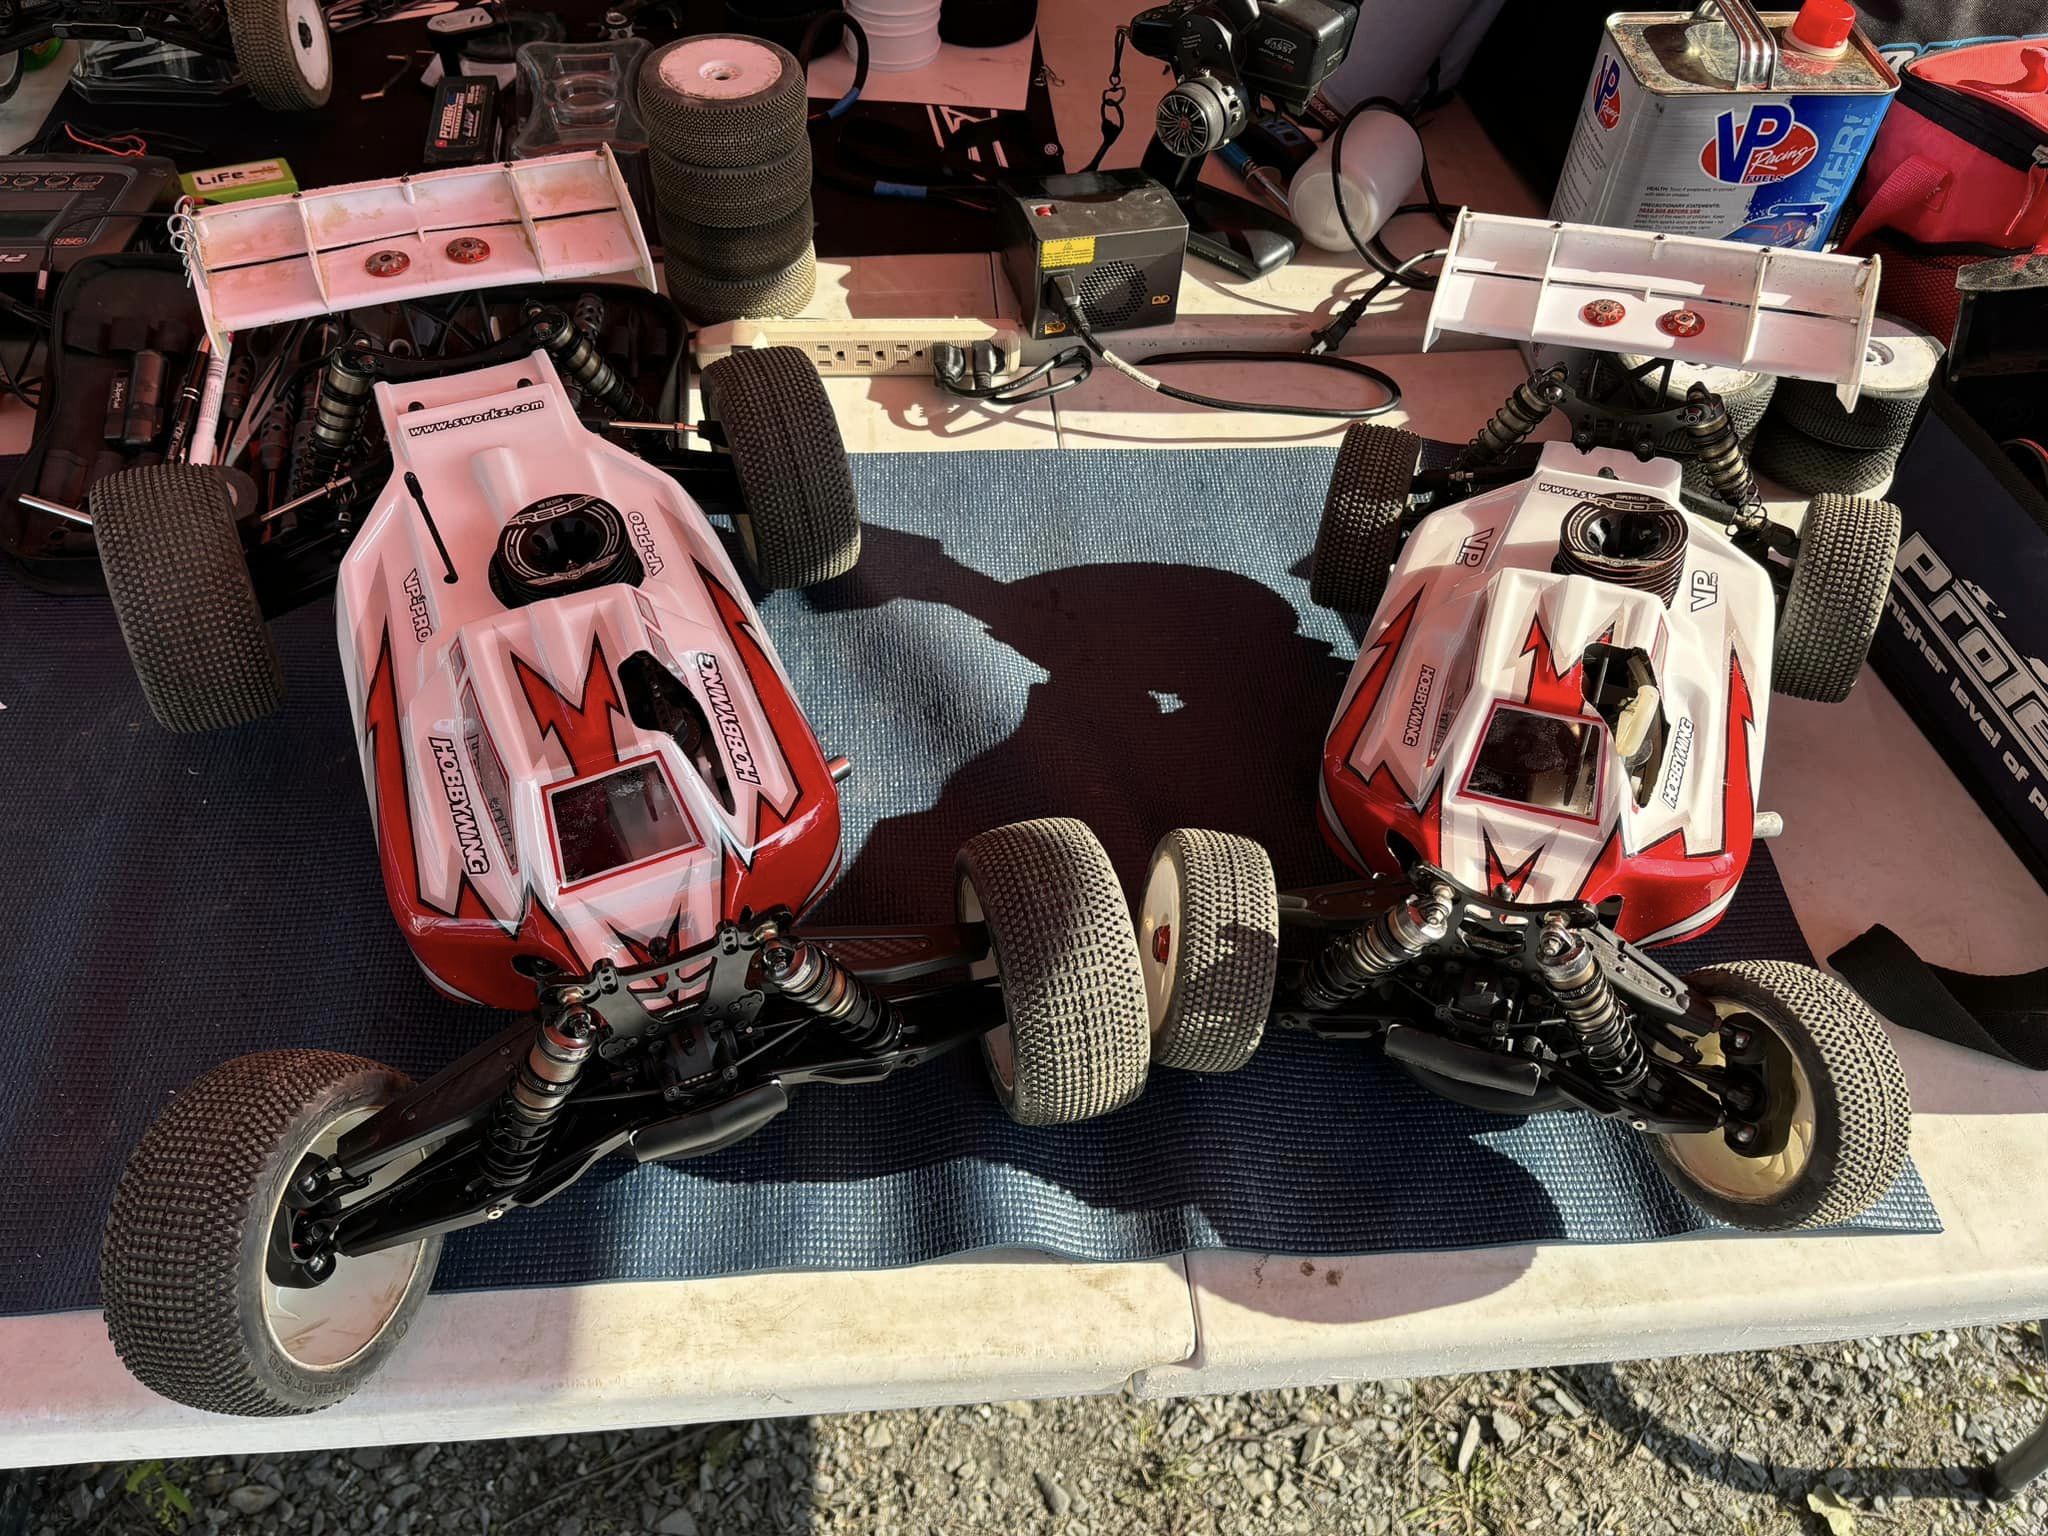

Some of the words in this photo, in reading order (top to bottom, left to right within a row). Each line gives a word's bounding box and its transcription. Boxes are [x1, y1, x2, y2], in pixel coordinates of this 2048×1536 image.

[1594, 54, 1620, 118] VP
[1715, 103, 1795, 184] VP
[1749, 146, 1817, 174] Racing
[196, 171, 245, 186] LiFe
[1744, 175, 1786, 184] FUELS
[408, 400, 545, 437] www.sworkz.com
[517, 497, 588, 525] REDS
[1596, 498, 1667, 512] REDS
[696, 652, 762, 786] HOBBYWING
[1403, 664, 1436, 747] HOBBYWING
[1885, 591, 1948, 675] higher
[1950, 676, 2002, 749] level
[2002, 749, 2030, 783] of
[2028, 786, 2048, 820] p
[1662, 717, 1695, 810] HOBBYWING
[428, 736, 491, 876] HOBBYWING
